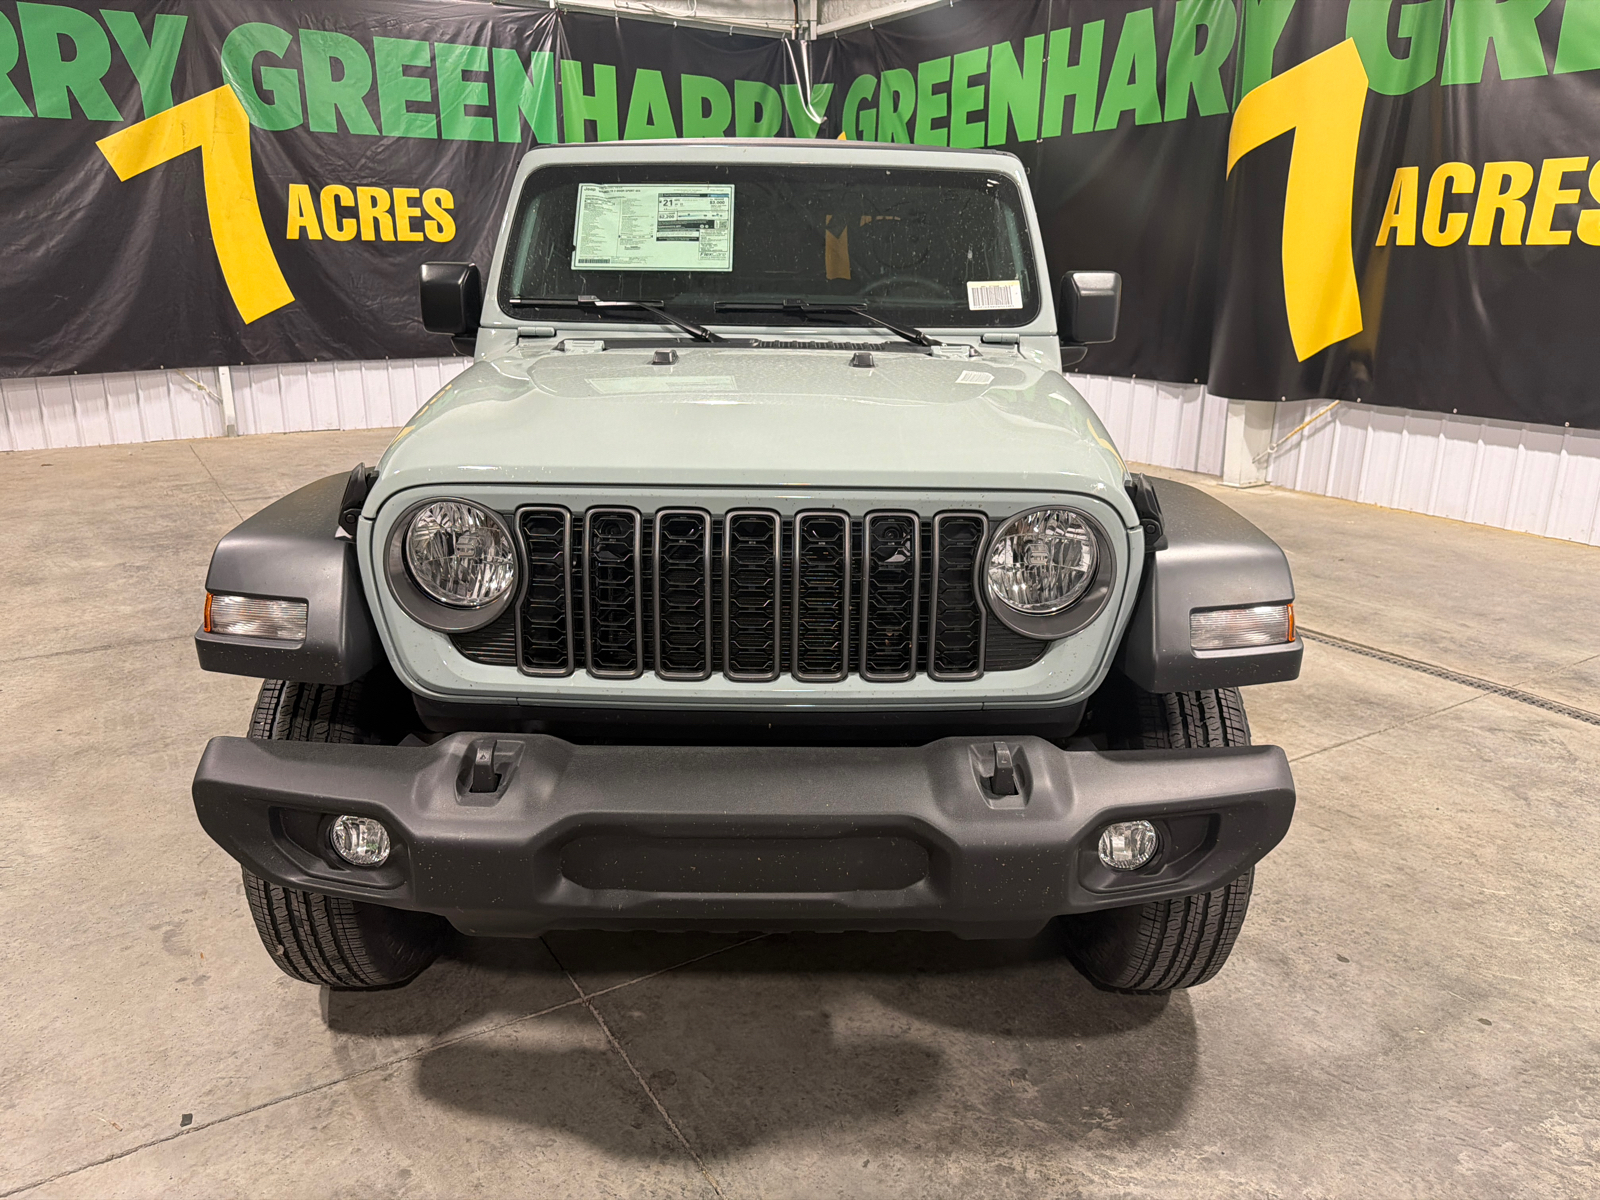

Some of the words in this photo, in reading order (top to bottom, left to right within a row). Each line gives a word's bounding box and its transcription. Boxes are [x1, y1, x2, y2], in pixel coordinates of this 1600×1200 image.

[221, 22, 558, 144] GREEN
[560, 59, 834, 143] HARRY
[842, 34, 1045, 149] GREEN
[95, 84, 295, 324] 7
[286, 183, 457, 243] ACRES
[662, 199, 673, 207] 21
[1226, 37, 1369, 362] 7
